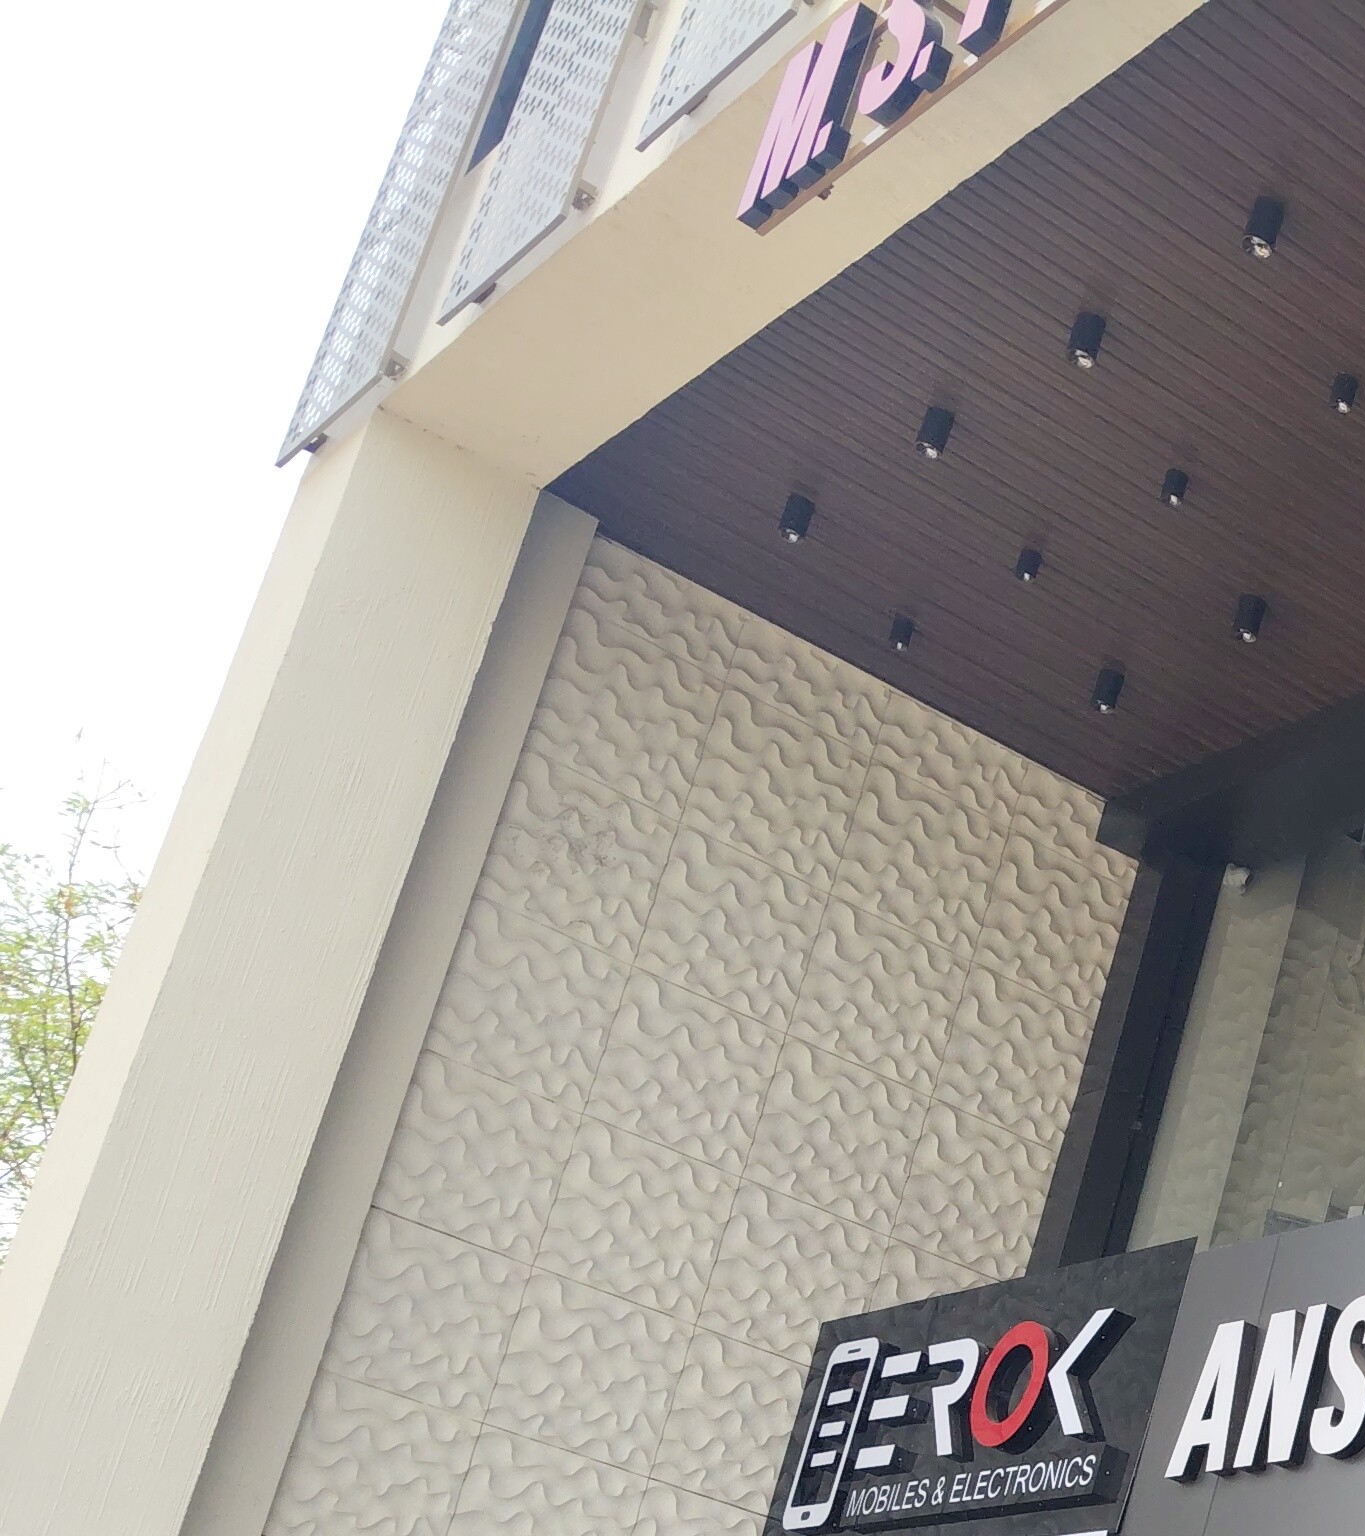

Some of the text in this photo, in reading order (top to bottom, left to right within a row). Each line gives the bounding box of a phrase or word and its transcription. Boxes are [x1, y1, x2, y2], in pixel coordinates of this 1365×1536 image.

[846, 1454, 1097, 1518] MOBILES & ELECTRONICS
